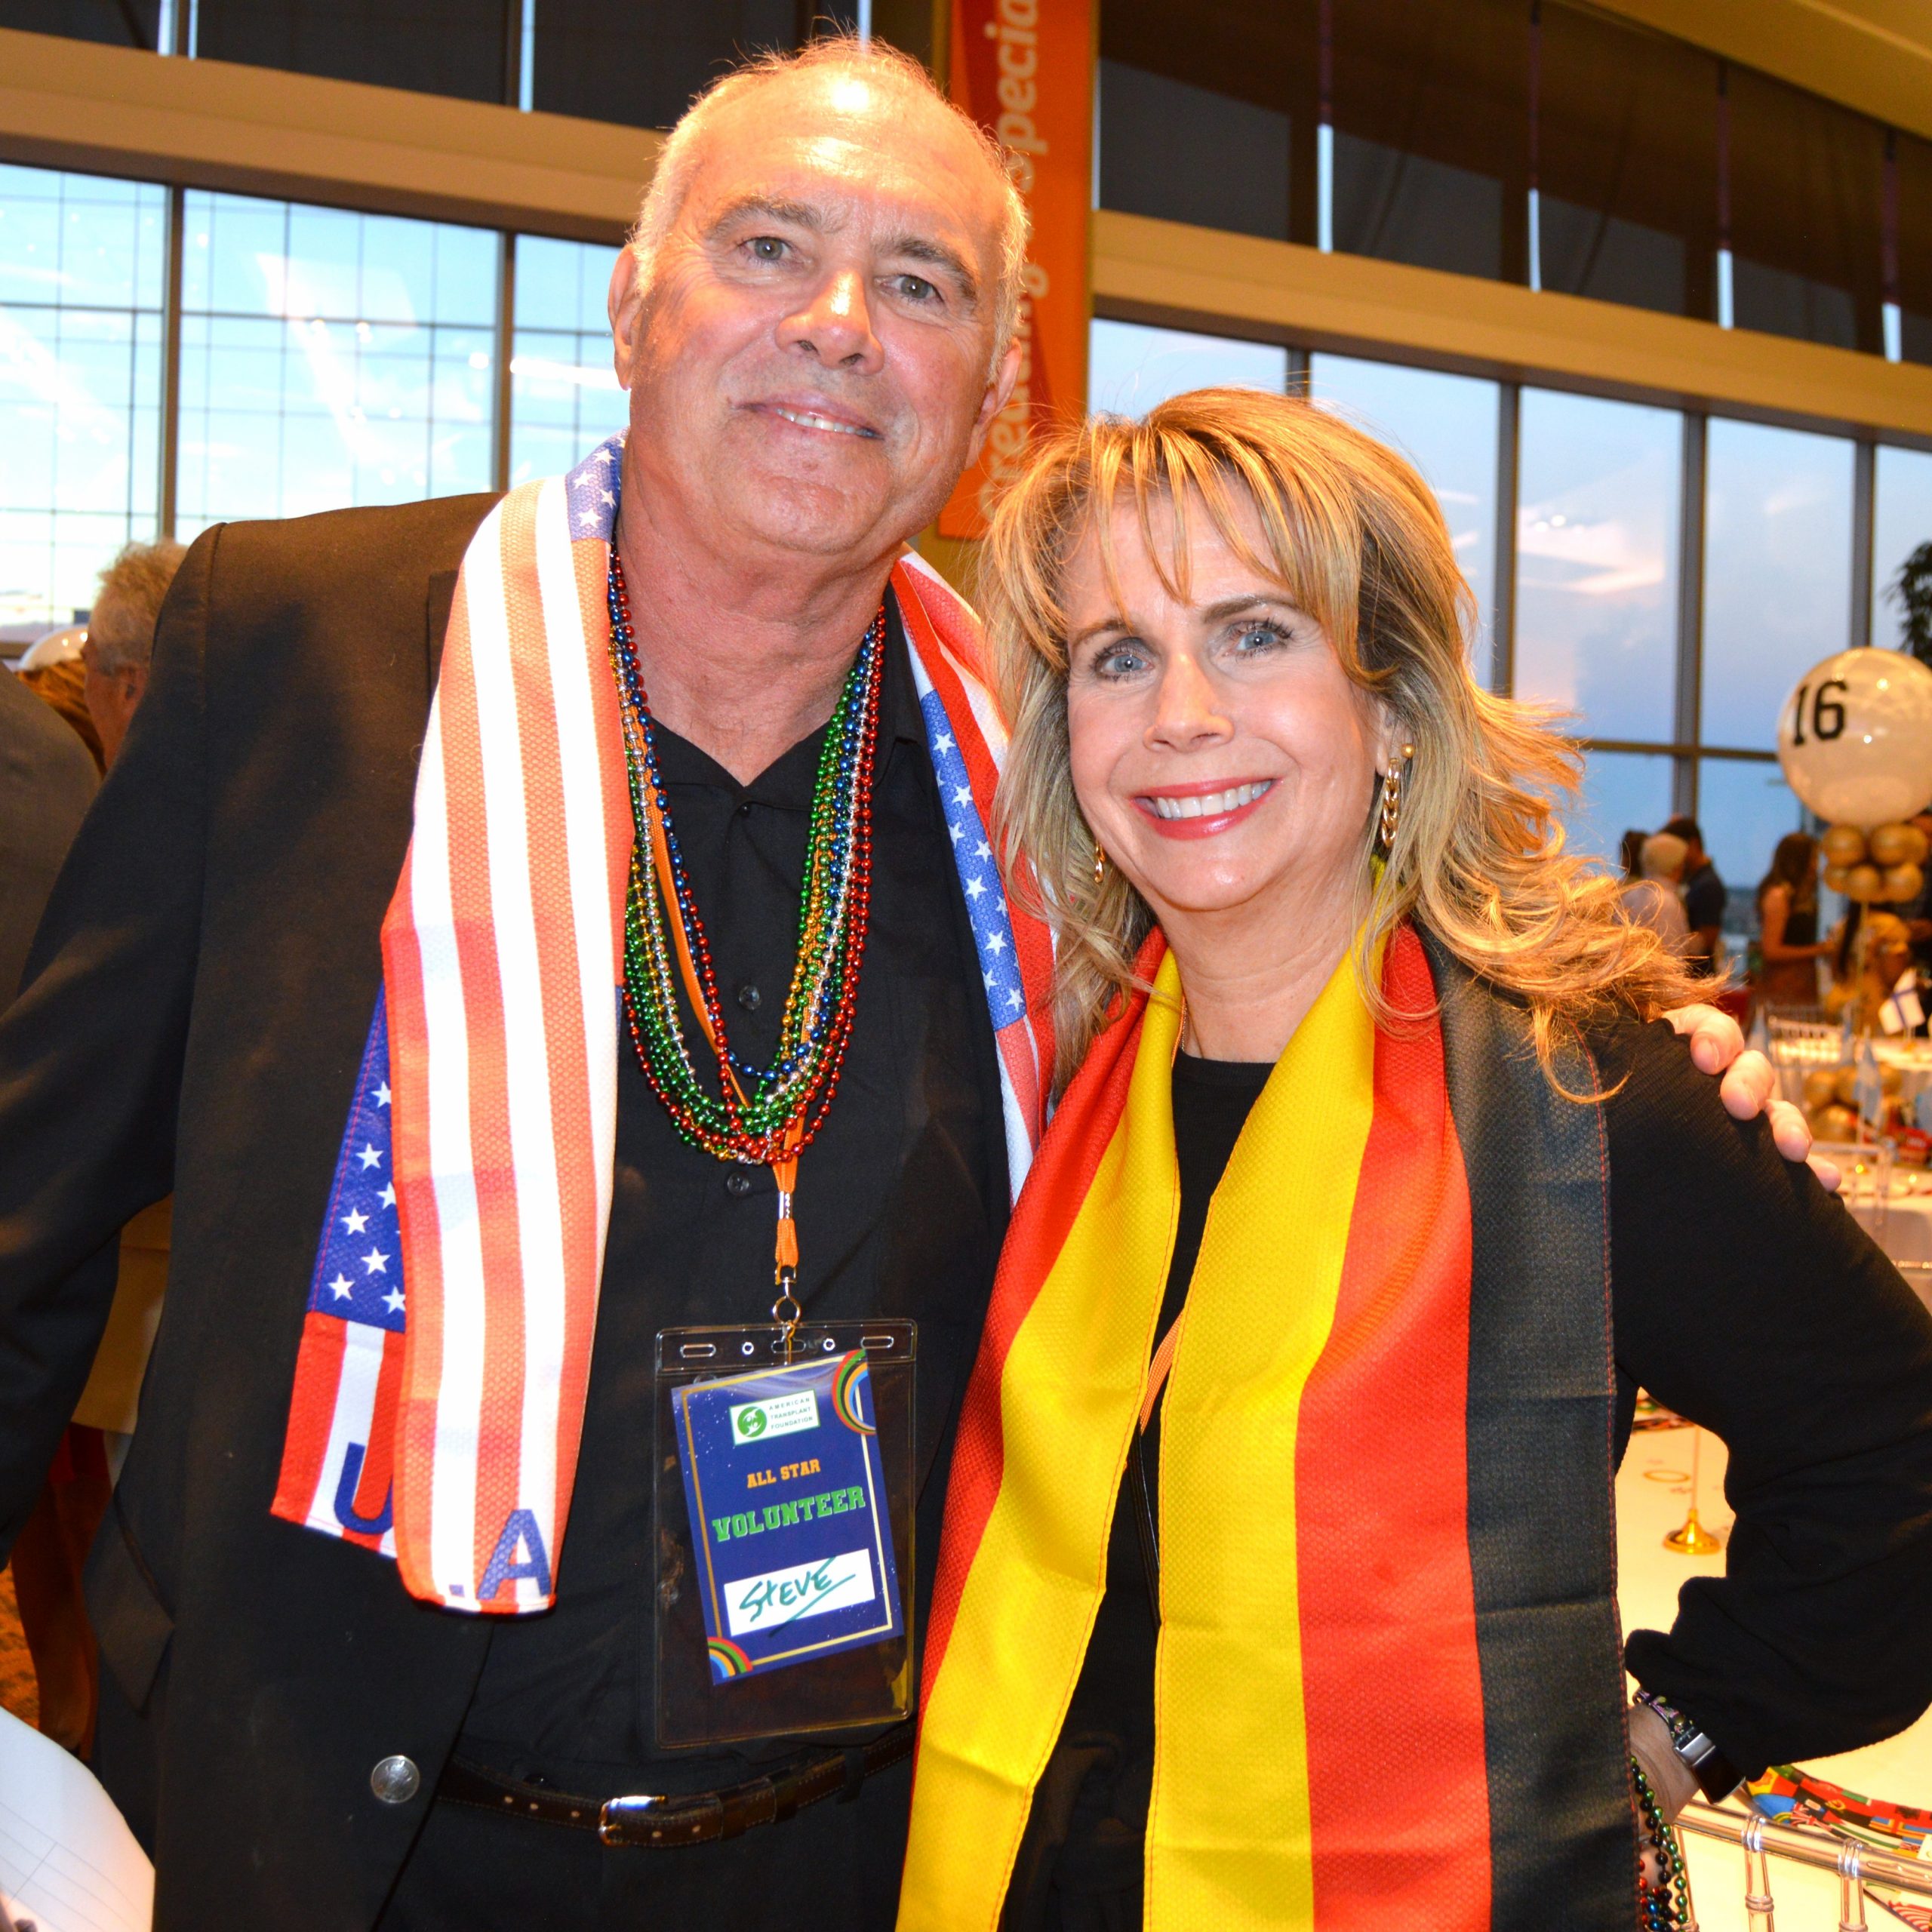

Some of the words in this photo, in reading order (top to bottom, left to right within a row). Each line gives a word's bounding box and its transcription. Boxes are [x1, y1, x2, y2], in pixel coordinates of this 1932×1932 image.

[1791, 680, 1849, 746] 16
[768, 1397, 811, 1411] AMERICAN
[770, 1406, 812, 1420] TRANSPLANT
[770, 1415, 814, 1430] FOUNDATION
[746, 1469, 777, 1489] ALL
[780, 1458, 821, 1481] STAR
[712, 1484, 866, 1543] VOLUNTEER
